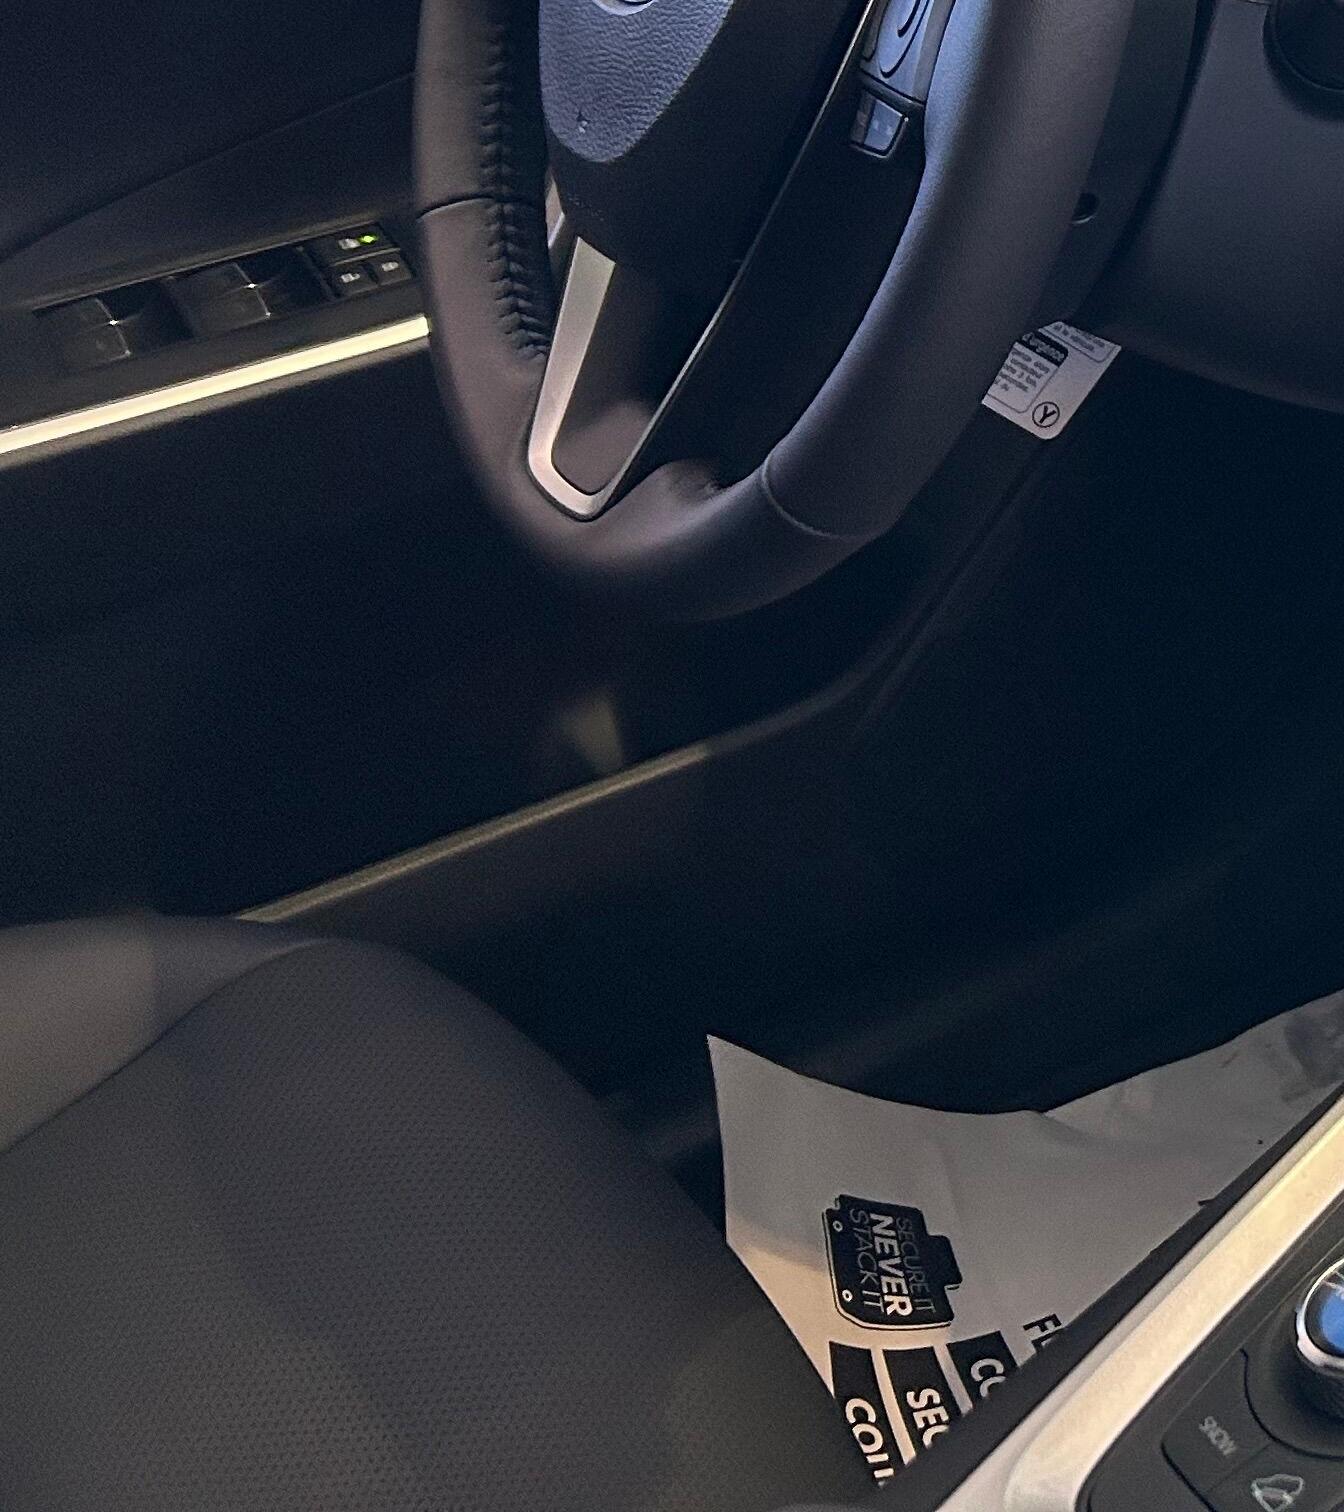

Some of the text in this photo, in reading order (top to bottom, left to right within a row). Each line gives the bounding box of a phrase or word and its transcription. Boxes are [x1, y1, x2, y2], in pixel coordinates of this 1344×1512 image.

[850, 1208, 884, 1313] STACK IT
[870, 1212, 913, 1317] NEVER
[896, 1216, 936, 1313] SECURE IT
